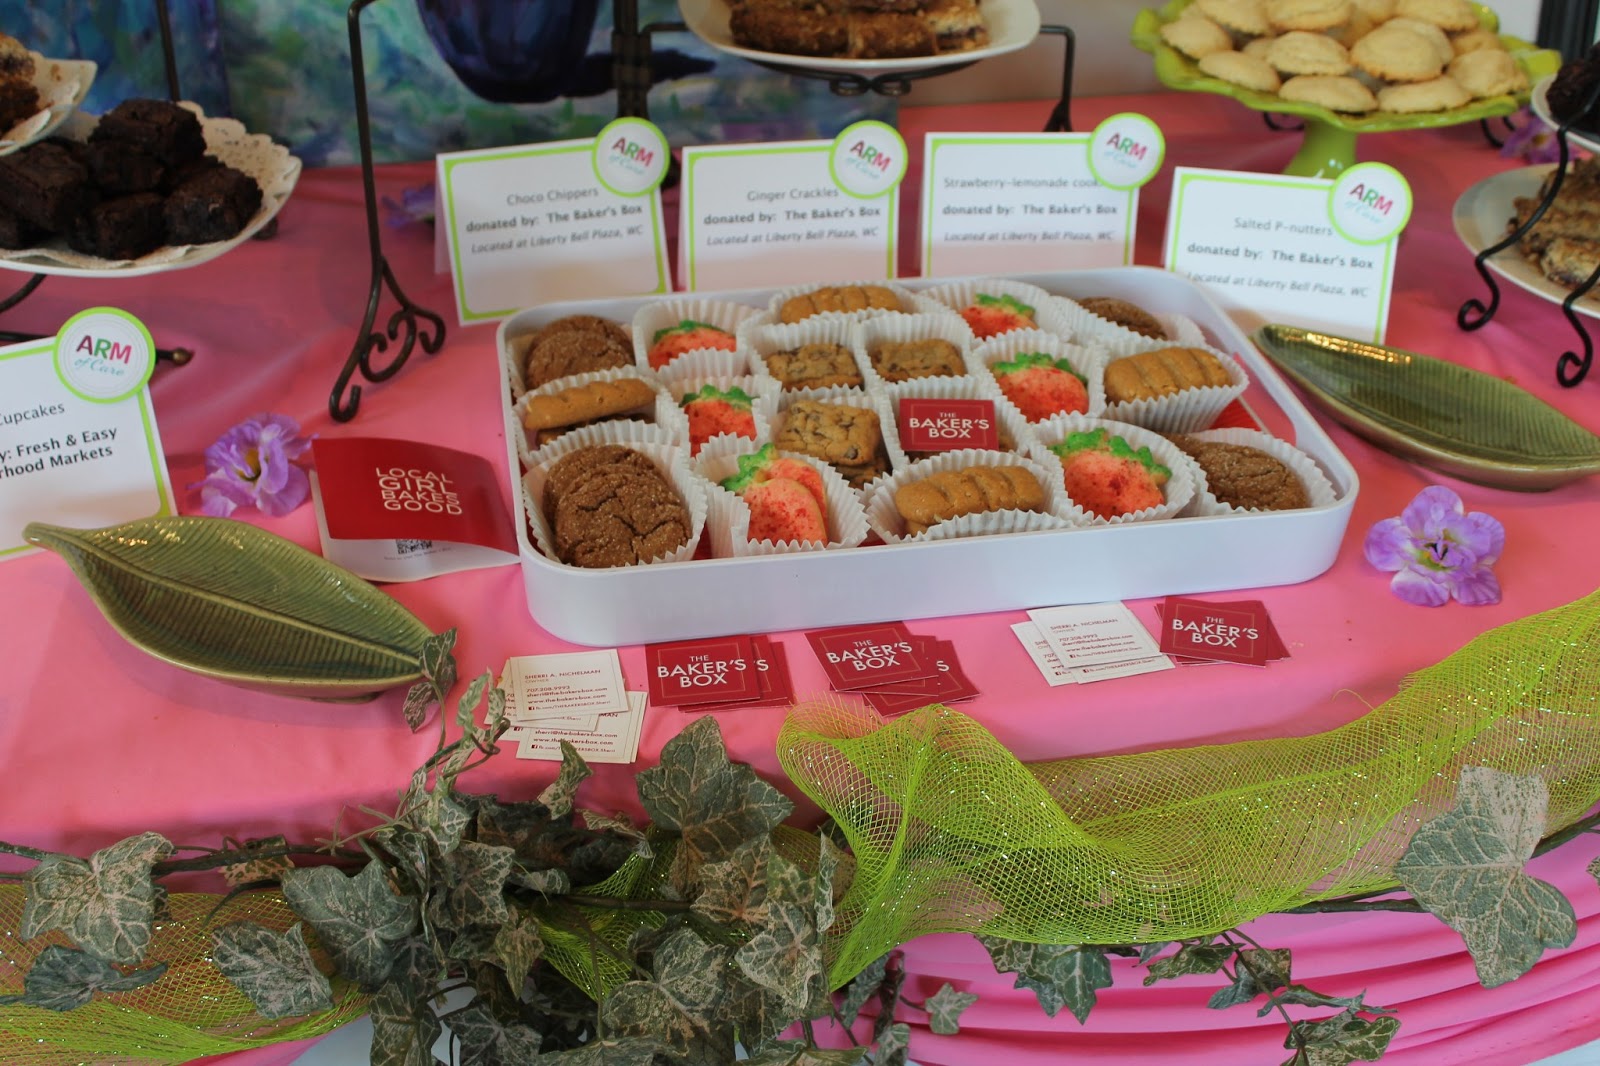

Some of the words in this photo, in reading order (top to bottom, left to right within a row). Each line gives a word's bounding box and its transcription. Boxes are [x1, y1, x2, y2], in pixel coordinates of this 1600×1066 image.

[612, 137, 654, 167] ARM
[849, 140, 892, 172] ARM
[1106, 132, 1147, 161] ARM
[944, 176, 1068, 189] Strawberry-lemonade
[507, 193, 543, 206] Choco
[547, 187, 598, 203] Chippers
[747, 190, 786, 203] Ginger
[790, 187, 839, 199] Crackles
[1349, 183, 1392, 215] ARM
[467, 217, 516, 232] donated
[521, 216, 539, 228] by:
[547, 212, 569, 223] The
[574, 207, 617, 220] Baker's
[621, 205, 642, 215] Box
[704, 214, 754, 225] donated
[759, 212, 777, 224] by:
[785, 210, 807, 220] The
[811, 207, 855, 218] Baker's
[859, 206, 881, 216] Box
[943, 205, 993, 216] donated
[997, 205, 1015, 216] by:
[1023, 205, 1045, 215] The
[1049, 205, 1092, 215] Baker's
[1096, 205, 1118, 215] Box
[707, 235, 748, 246] Located
[751, 233, 762, 243] at
[765, 230, 801, 242] Liberty
[806, 229, 824, 240] Bell
[862, 226, 879, 236] WC
[944, 231, 985, 242] Located
[988, 232, 999, 241] at
[1002, 231, 1038, 242] Liberty
[1042, 231, 1060, 241] Bell
[1097, 232, 1114, 241] WC
[1234, 217, 1271, 231] Salted
[1275, 219, 1333, 237] P-nutters
[471, 239, 513, 254] Located
[516, 236, 527, 247] at
[530, 231, 567, 248] Liberty
[571, 230, 589, 242] Bell
[627, 225, 643, 236] WC
[1187, 243, 1239, 257] donated
[1244, 247, 1263, 260] by:
[1272, 250, 1295, 262] The
[1300, 253, 1346, 267] Baker's
[1350, 257, 1373, 269] Box
[1233, 275, 1245, 286] at
[1248, 276, 1286, 292] Liberty
[1290, 280, 1310, 292] Bell
[1350, 287, 1369, 298] WC
[76, 334, 132, 365] ARM
[90, 359, 125, 377] Care
[909, 417, 990, 430] BAKER'S
[928, 427, 971, 439] BOX
[16, 437, 60, 458] Fresh
[66, 433, 77, 447] &
[82, 427, 118, 444] Easy
[50, 445, 113, 468] Markets
[376, 467, 453, 484] LOCAL
[379, 476, 457, 496] GIRL
[381, 489, 460, 505] BAKES
[384, 500, 462, 515] GOOD
[1172, 619, 1259, 640] BAKER'S
[1205, 616, 1224, 624] THE
[852, 639, 873, 647] THE
[1191, 632, 1237, 648] BOX
[689, 654, 709, 662] THE
[826, 641, 913, 664] BAKER'S
[657, 658, 747, 678] BAKER'S
[852, 655, 901, 672] BOX
[679, 673, 728, 688] BOX
